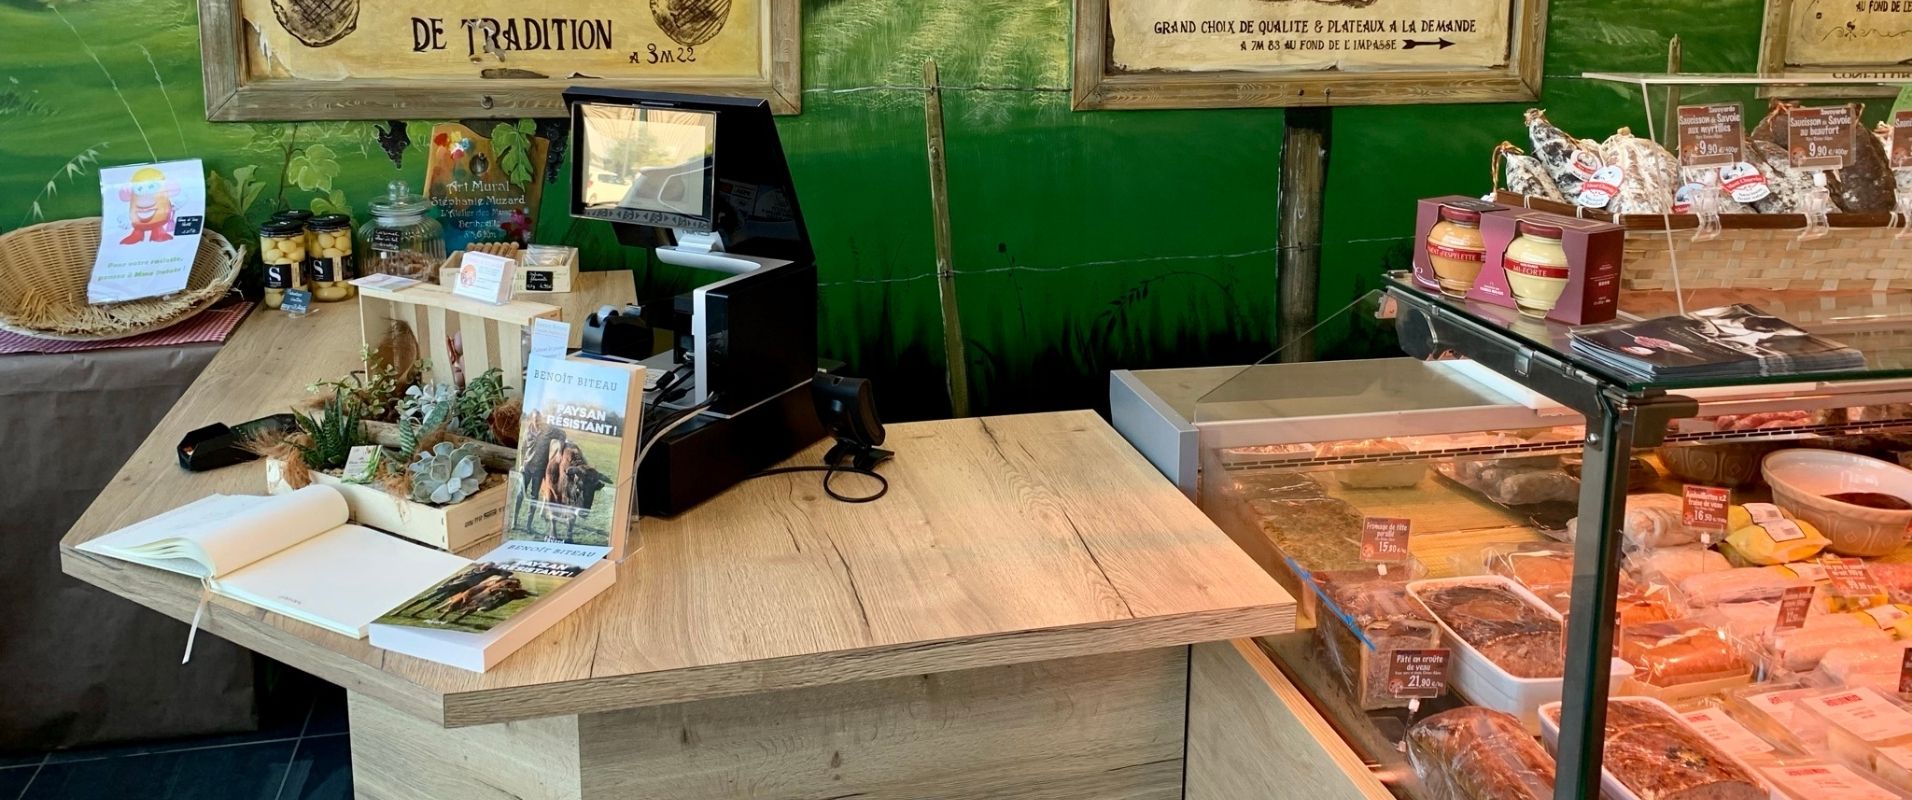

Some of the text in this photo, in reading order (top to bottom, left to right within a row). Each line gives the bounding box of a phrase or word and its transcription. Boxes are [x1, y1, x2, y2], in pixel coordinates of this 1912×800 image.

[1869, 0, 1888, 14] FOND
[1891, 0, 1900, 12] DE
[1154, 19, 1477, 34] GRAND CHOIX DE QUALITE & PLATEAUX A LA DEMANDE
[411, 17, 613, 56] DE TRADITION
[1251, 41, 1264, 51] 7M
[1268, 39, 1281, 51] 83
[1285, 40, 1297, 51] AU
[1300, 40, 1325, 51] FOND
[1328, 40, 1340, 51] DE
[629, 43, 697, 64] A 3M22
[1680, 115, 1710, 125] Saucisson
[1717, 113, 1740, 123] Savoie
[1790, 117, 1821, 127] Saucisson
[1828, 115, 1851, 125] Savoie
[1688, 124, 1731, 135] aux myrtilles
[1810, 126, 1839, 136] beaufort
[471, 181, 510, 192] Mural
[269, 267, 282, 282] S
[534, 369, 618, 391] BENOÎT BITEAU
[557, 404, 607, 421] PAYSAN
[552, 548, 597, 557] BITEAU
[1396, 654, 1411, 664] Pâté
[1422, 654, 1444, 663] croûte
[1406, 663, 1415, 671] de
